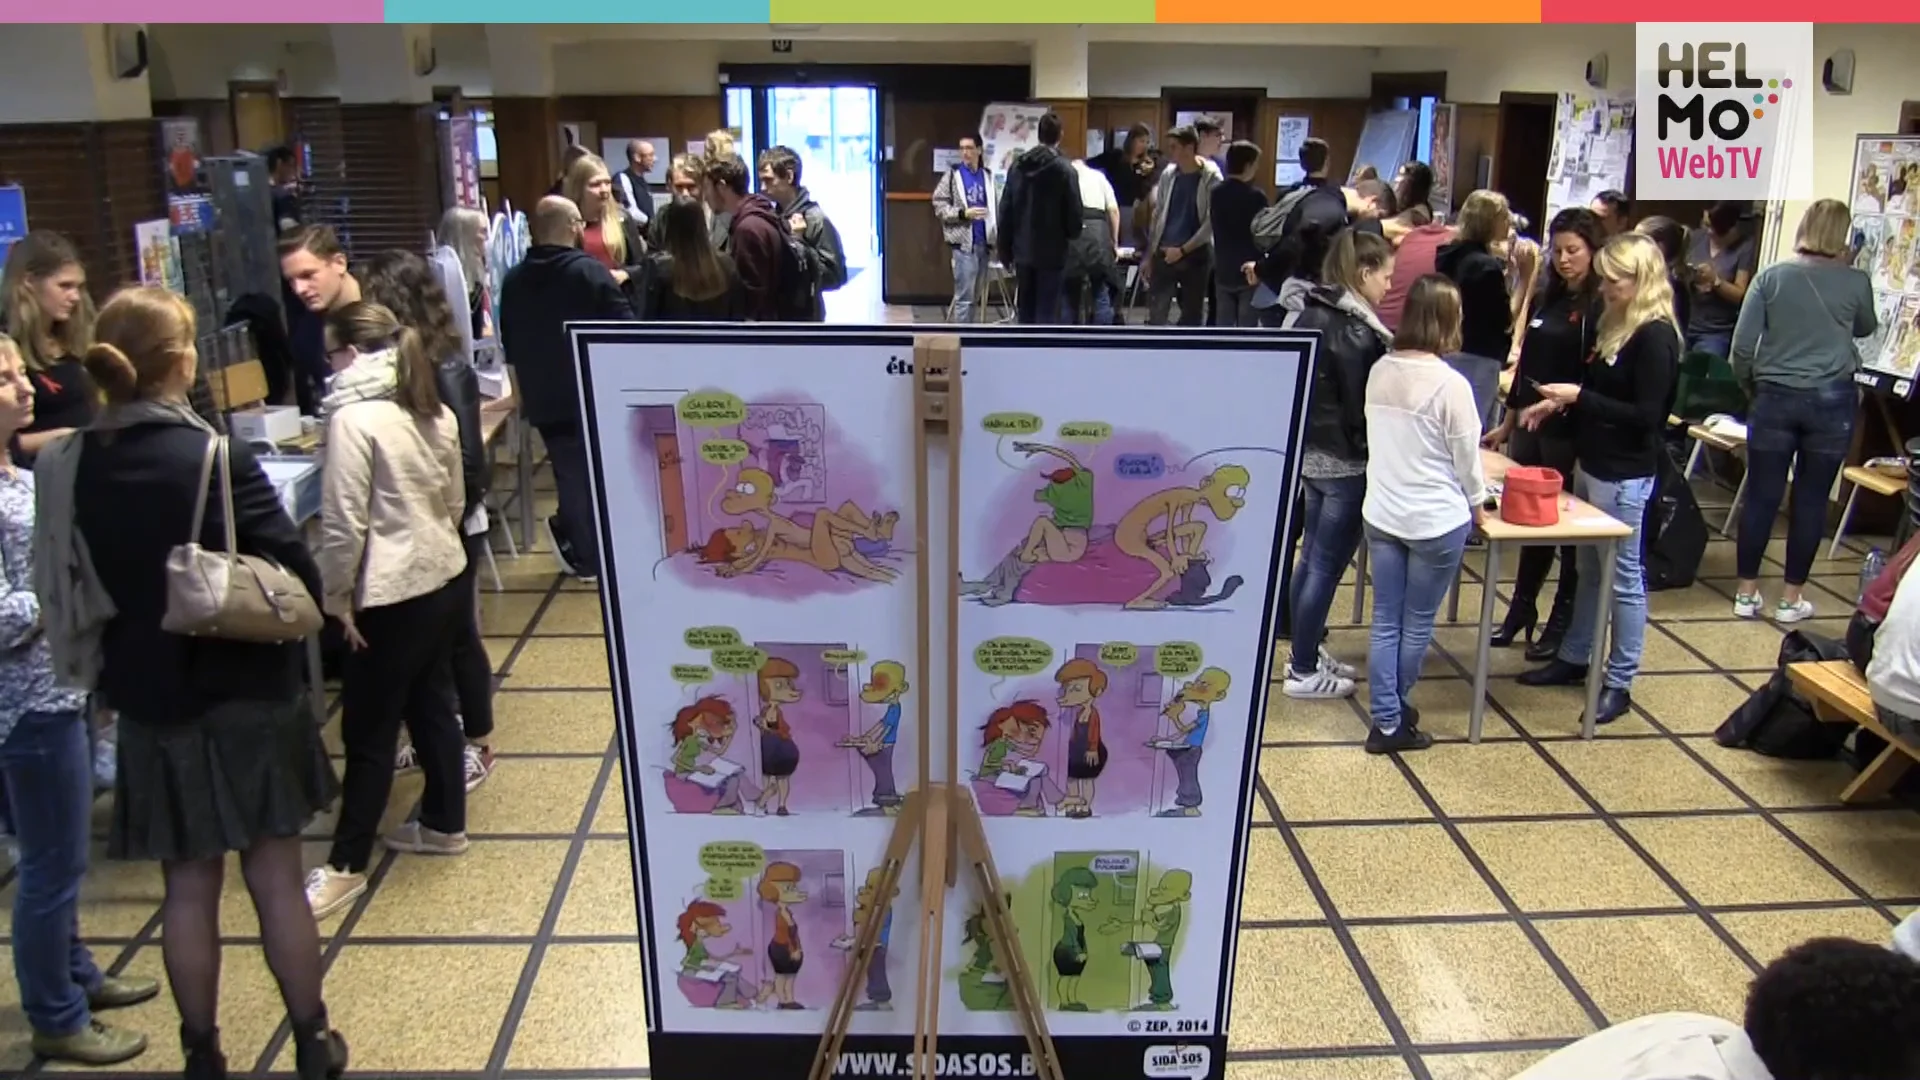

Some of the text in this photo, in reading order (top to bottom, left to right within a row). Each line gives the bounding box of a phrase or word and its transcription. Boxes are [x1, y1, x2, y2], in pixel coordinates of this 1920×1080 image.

[1176, 1020, 1209, 1033] 2014
[1151, 1055, 1178, 1067] SIDA
[1180, 1052, 1204, 1065] SOS
